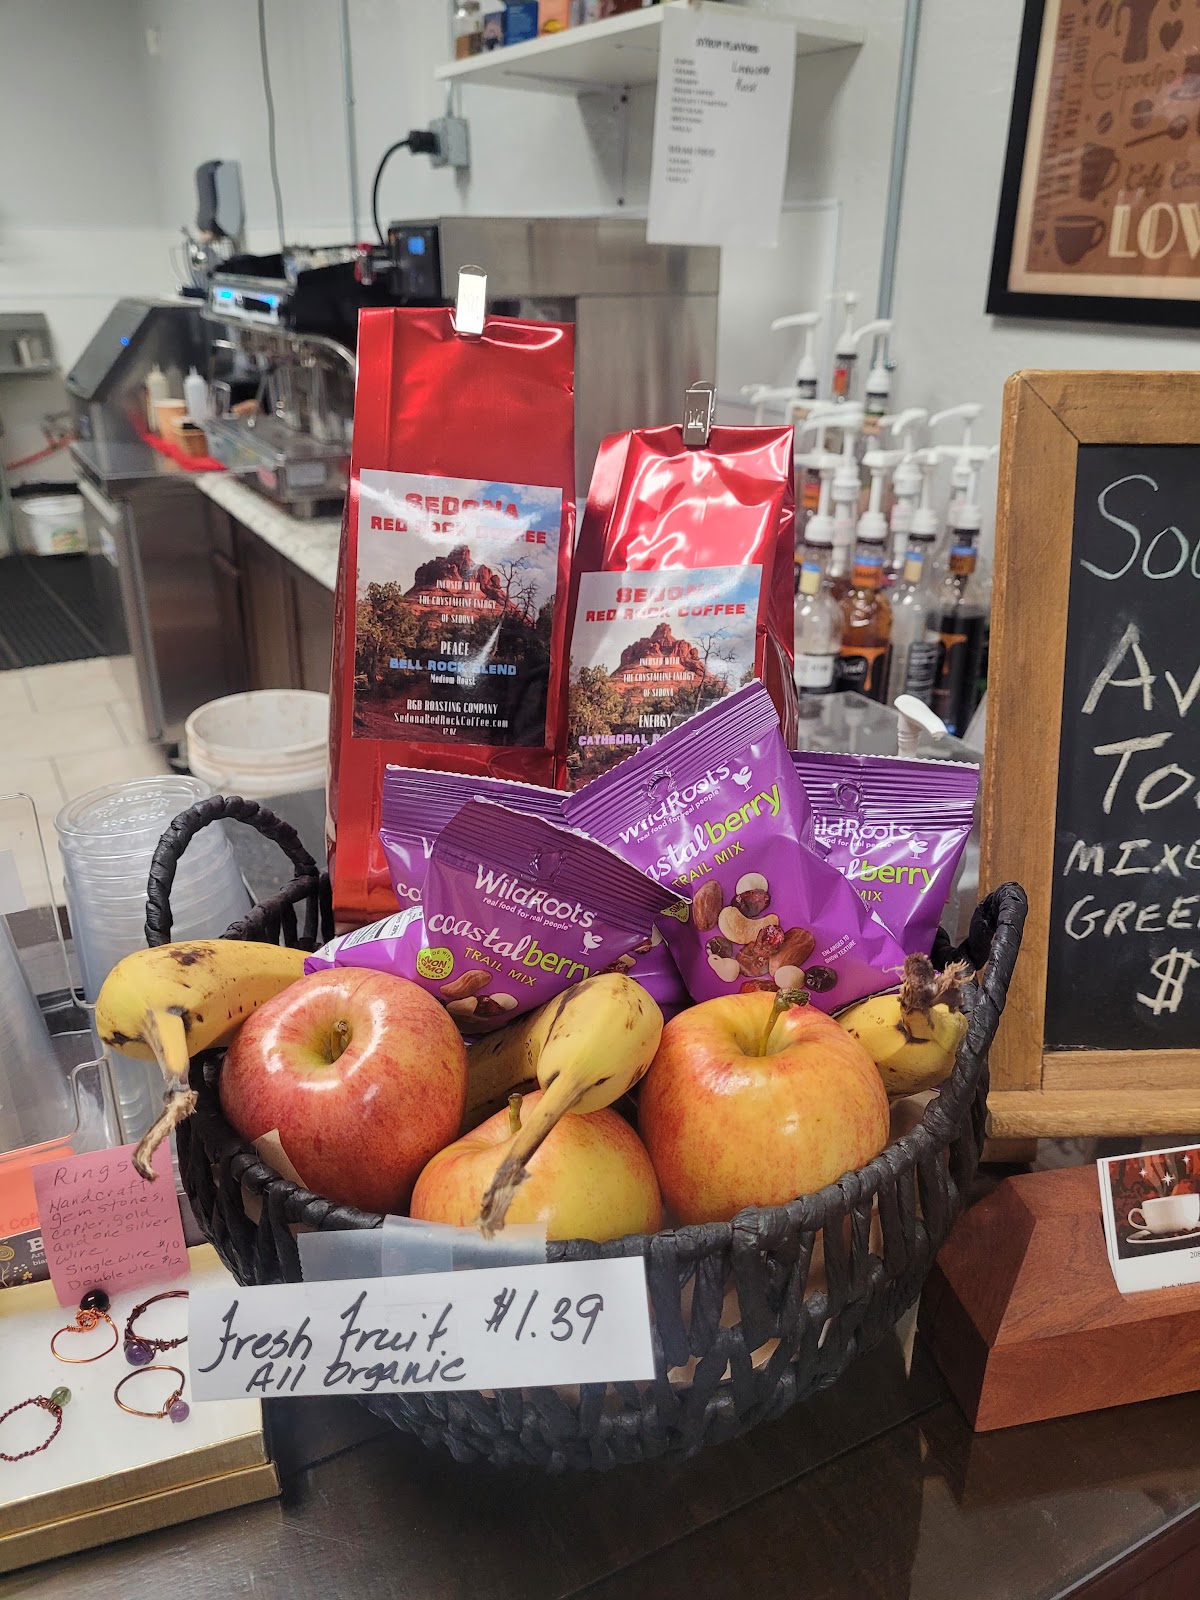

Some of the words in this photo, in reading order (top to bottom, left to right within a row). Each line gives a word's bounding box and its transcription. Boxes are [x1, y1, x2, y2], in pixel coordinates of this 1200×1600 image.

[371, 516, 408, 532] RED
[1080, 474, 1200, 580] So
[419, 595, 430, 605] THE
[616, 583, 720, 603] SEDON
[441, 613, 449, 623] OF
[451, 614, 475, 625] SEDONA
[585, 609, 616, 622] RED
[677, 603, 746, 617] COFFEE
[440, 641, 470, 656] PEACE
[389, 657, 423, 671] BELL
[427, 660, 464, 673] ROCK
[471, 662, 517, 675] BLEND
[430, 673, 455, 685] Medium
[456, 674, 476, 686] Roast
[643, 689, 651, 697] OF
[652, 688, 674, 697] SEDONA
[424, 700, 462, 713] ROASTING
[463, 702, 498, 715] COMPANY
[394, 712, 509, 728] SedonaRedRockCoffee.com
[638, 714, 674, 728] ENERGY
[578, 733, 648, 746] CATHEDRAL
[1093, 731, 1200, 815] To
[637, 832, 650, 844] real
[651, 817, 668, 834] food
[668, 815, 681, 824] for
[682, 804, 695, 817] real
[695, 788, 720, 809] people
[643, 784, 781, 881] astalberry
[814, 816, 912, 840] ildRoots
[837, 838, 849, 847] for
[671, 861, 713, 888] TRAIL
[714, 841, 745, 865] MIX
[475, 864, 597, 928] WildRoots
[482, 897, 499, 907] real
[498, 901, 517, 913] food
[517, 908, 530, 919] for
[529, 915, 544, 923] real
[543, 919, 569, 931] people
[1064, 894, 1200, 940] GREE
[428, 913, 600, 981] coastalberry
[837, 939, 857, 956] TEXTURE
[421, 958, 444, 974] GMO
[425, 955, 447, 968] NON
[465, 946, 503, 973] TRAIL
[508, 969, 538, 987] MIX
[54, 1161, 128, 1186] Rings
[50, 1208, 92, 1230] gem
[113, 1209, 156, 1226] gold
[53, 1234, 91, 1252] and
[92, 1230, 120, 1239] one
[125, 1216, 173, 1232] silver
[65, 1258, 116, 1276] Single
[118, 1249, 159, 1263] wire
[156, 1240, 180, 1253] $10
[68, 1270, 126, 1290] Double
[128, 1263, 160, 1275] wire
[484, 1287, 604, 1344] $1.39
[245, 1361, 307, 1393] All
